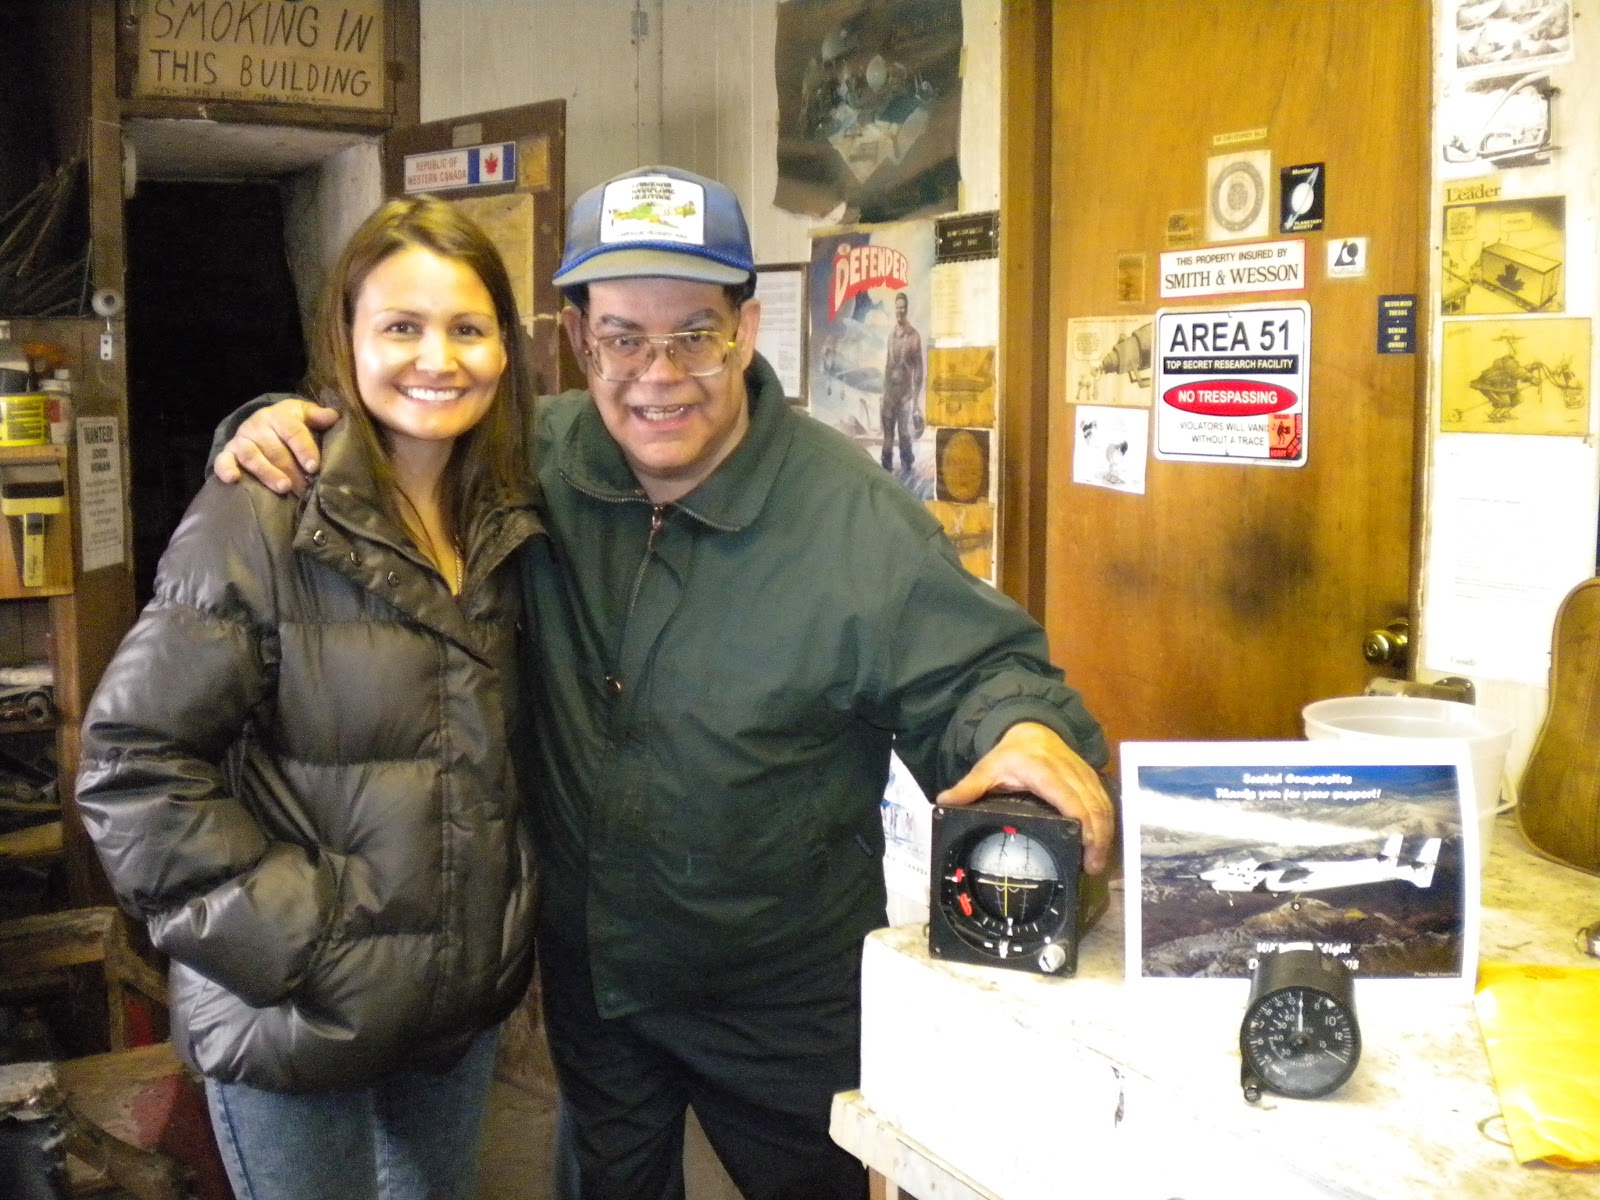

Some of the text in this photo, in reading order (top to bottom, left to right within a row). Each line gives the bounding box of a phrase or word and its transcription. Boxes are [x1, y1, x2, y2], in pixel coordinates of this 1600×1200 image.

[154, 0, 374, 52] SMOKING IN
[151, 50, 371, 97] THIS BUILDING
[415, 156, 458, 171] REPUBLIC OF
[407, 169, 467, 186] WESTERN CANADA
[1446, 184, 1501, 202] Leader
[1294, 218, 1323, 226] PLANETARY
[1177, 248, 1288, 266] THIS PROPERTY INSURED BY
[831, 246, 909, 315] DEFENDER
[1165, 264, 1299, 290] SMITH & WESSON
[1169, 319, 1290, 353] AREA 51
[1166, 359, 1294, 370] TOP SECRET RESEARCH FACILITY
[1178, 390, 1278, 405] NO TRESPASSING
[1180, 421, 1224, 431] VIOLATORS
[1226, 422, 1245, 432] WILL
[1191, 435, 1265, 446] WITHOUT A TRACE
[1325, 1016, 1337, 1026] 10
